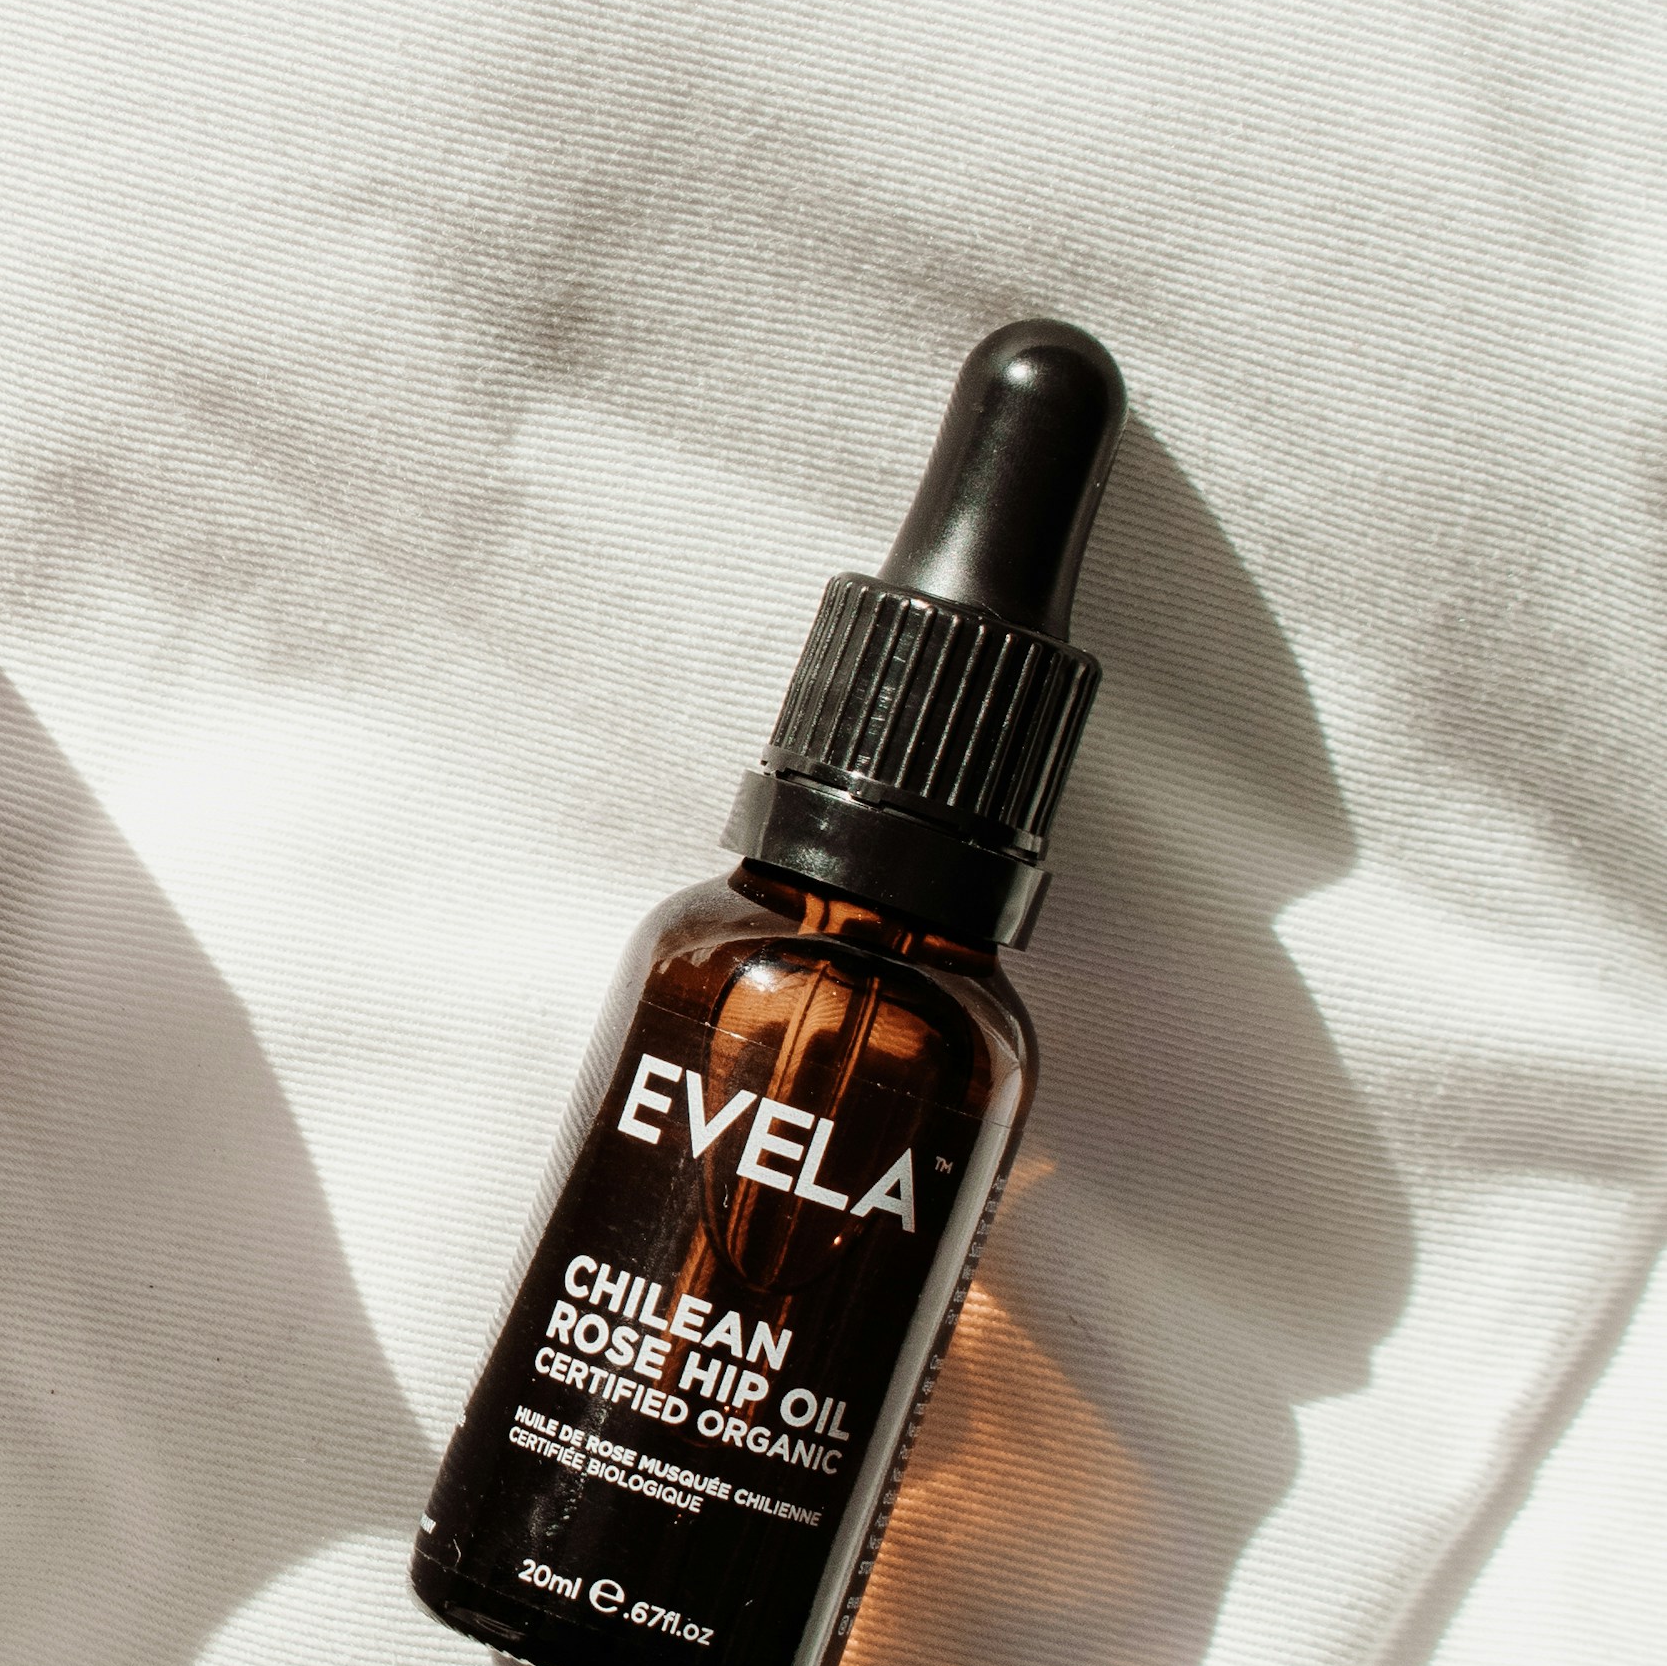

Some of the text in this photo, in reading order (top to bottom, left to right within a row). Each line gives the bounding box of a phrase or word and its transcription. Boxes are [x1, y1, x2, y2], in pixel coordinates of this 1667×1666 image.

[617, 1053, 916, 1233] EVELA
[545, 1299, 851, 1442] ROSE HIP OIL
[564, 1254, 793, 1371] CHILEAN
[509, 1426, 704, 1514] CERTIFIÉE BIOLOGIQUE
[514, 1405, 824, 1528] HUILE DE ROSE MUSQUÉE CHILIENNE
[534, 1346, 843, 1475] CERTIFIED ORGANIC
[518, 1558, 583, 1601] 20ml
